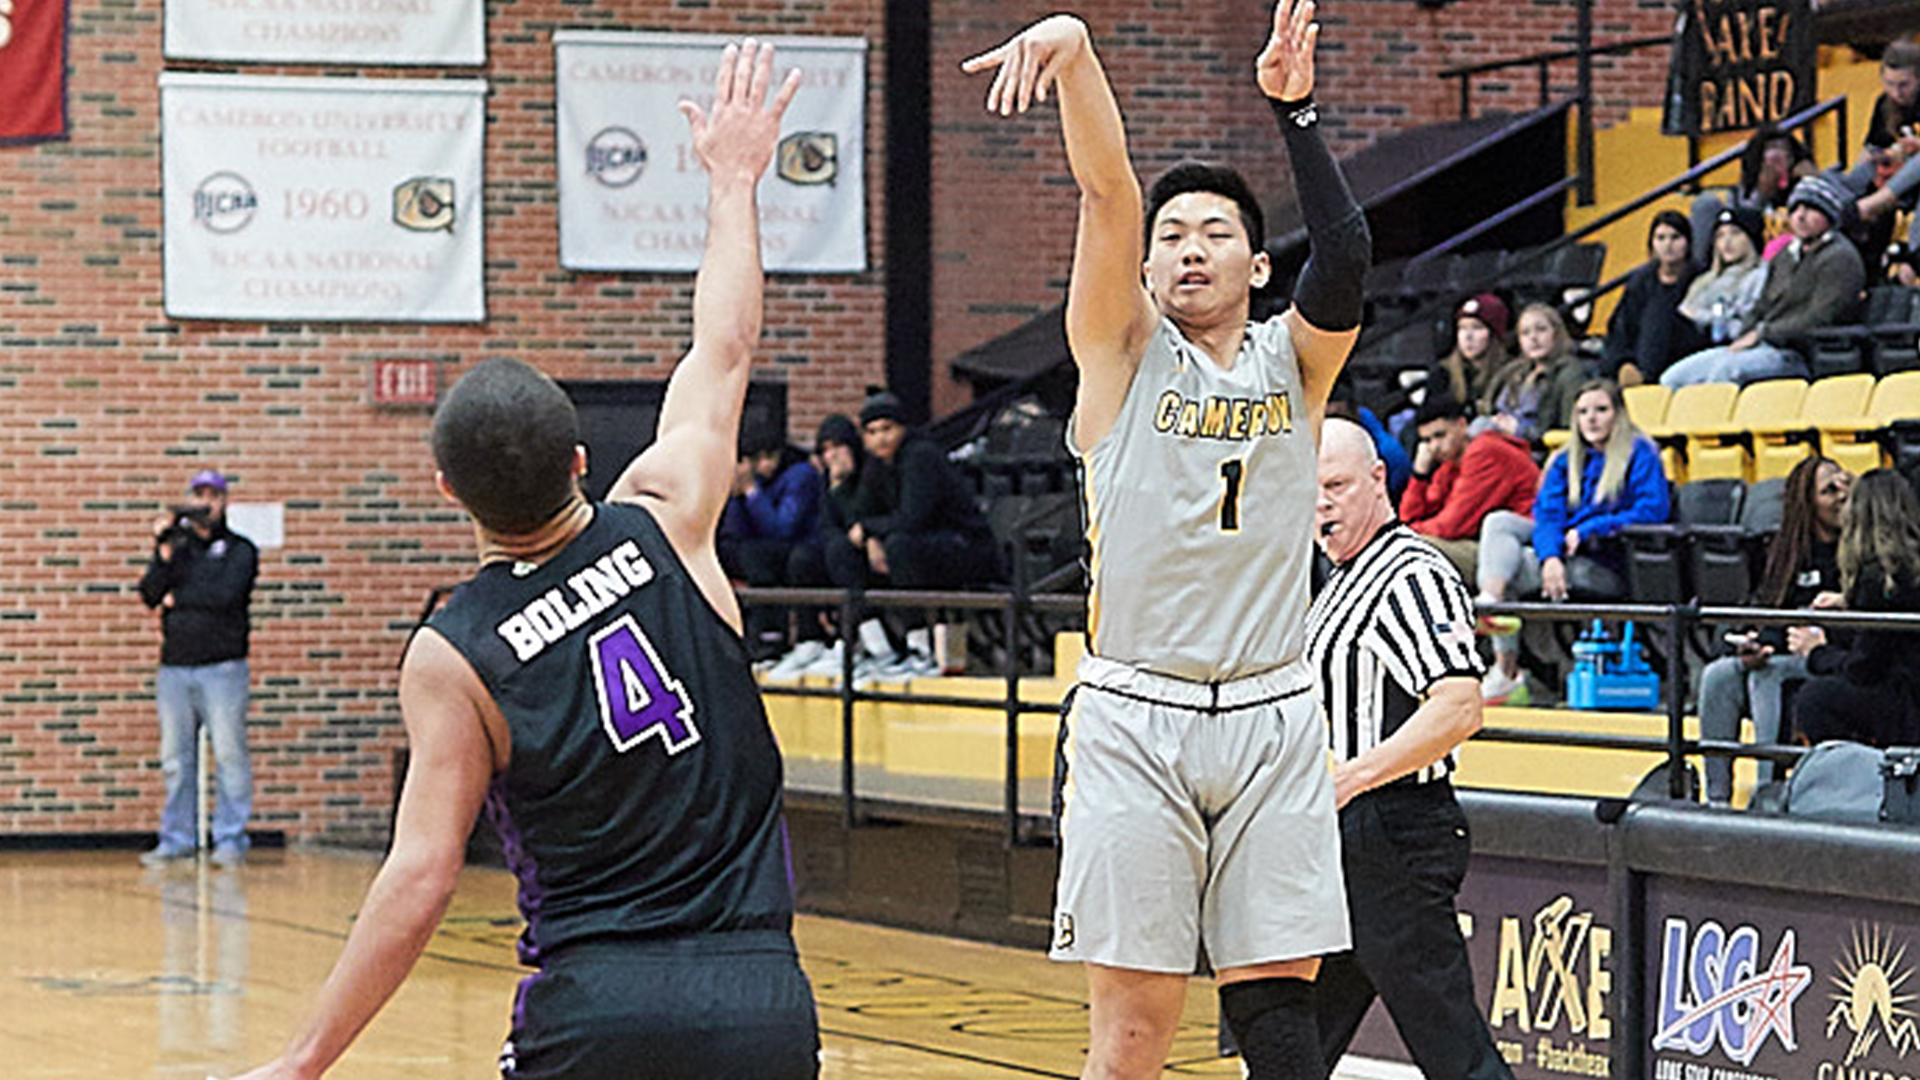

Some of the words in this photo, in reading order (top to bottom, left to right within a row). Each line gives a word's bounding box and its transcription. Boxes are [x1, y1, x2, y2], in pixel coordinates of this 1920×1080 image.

[567, 61, 694, 85] CAMERON
[176, 107, 304, 131] CAMERON
[312, 109, 467, 134] UNIVERSITY
[257, 138, 390, 160] FOOTBALL
[282, 189, 370, 221] 1960
[305, 250, 438, 273] NATIONAL
[243, 279, 404, 300] CHAMPIONS
[1218, 457, 1246, 534] 1
[497, 540, 656, 663] BOLING
[588, 612, 702, 757] 4
